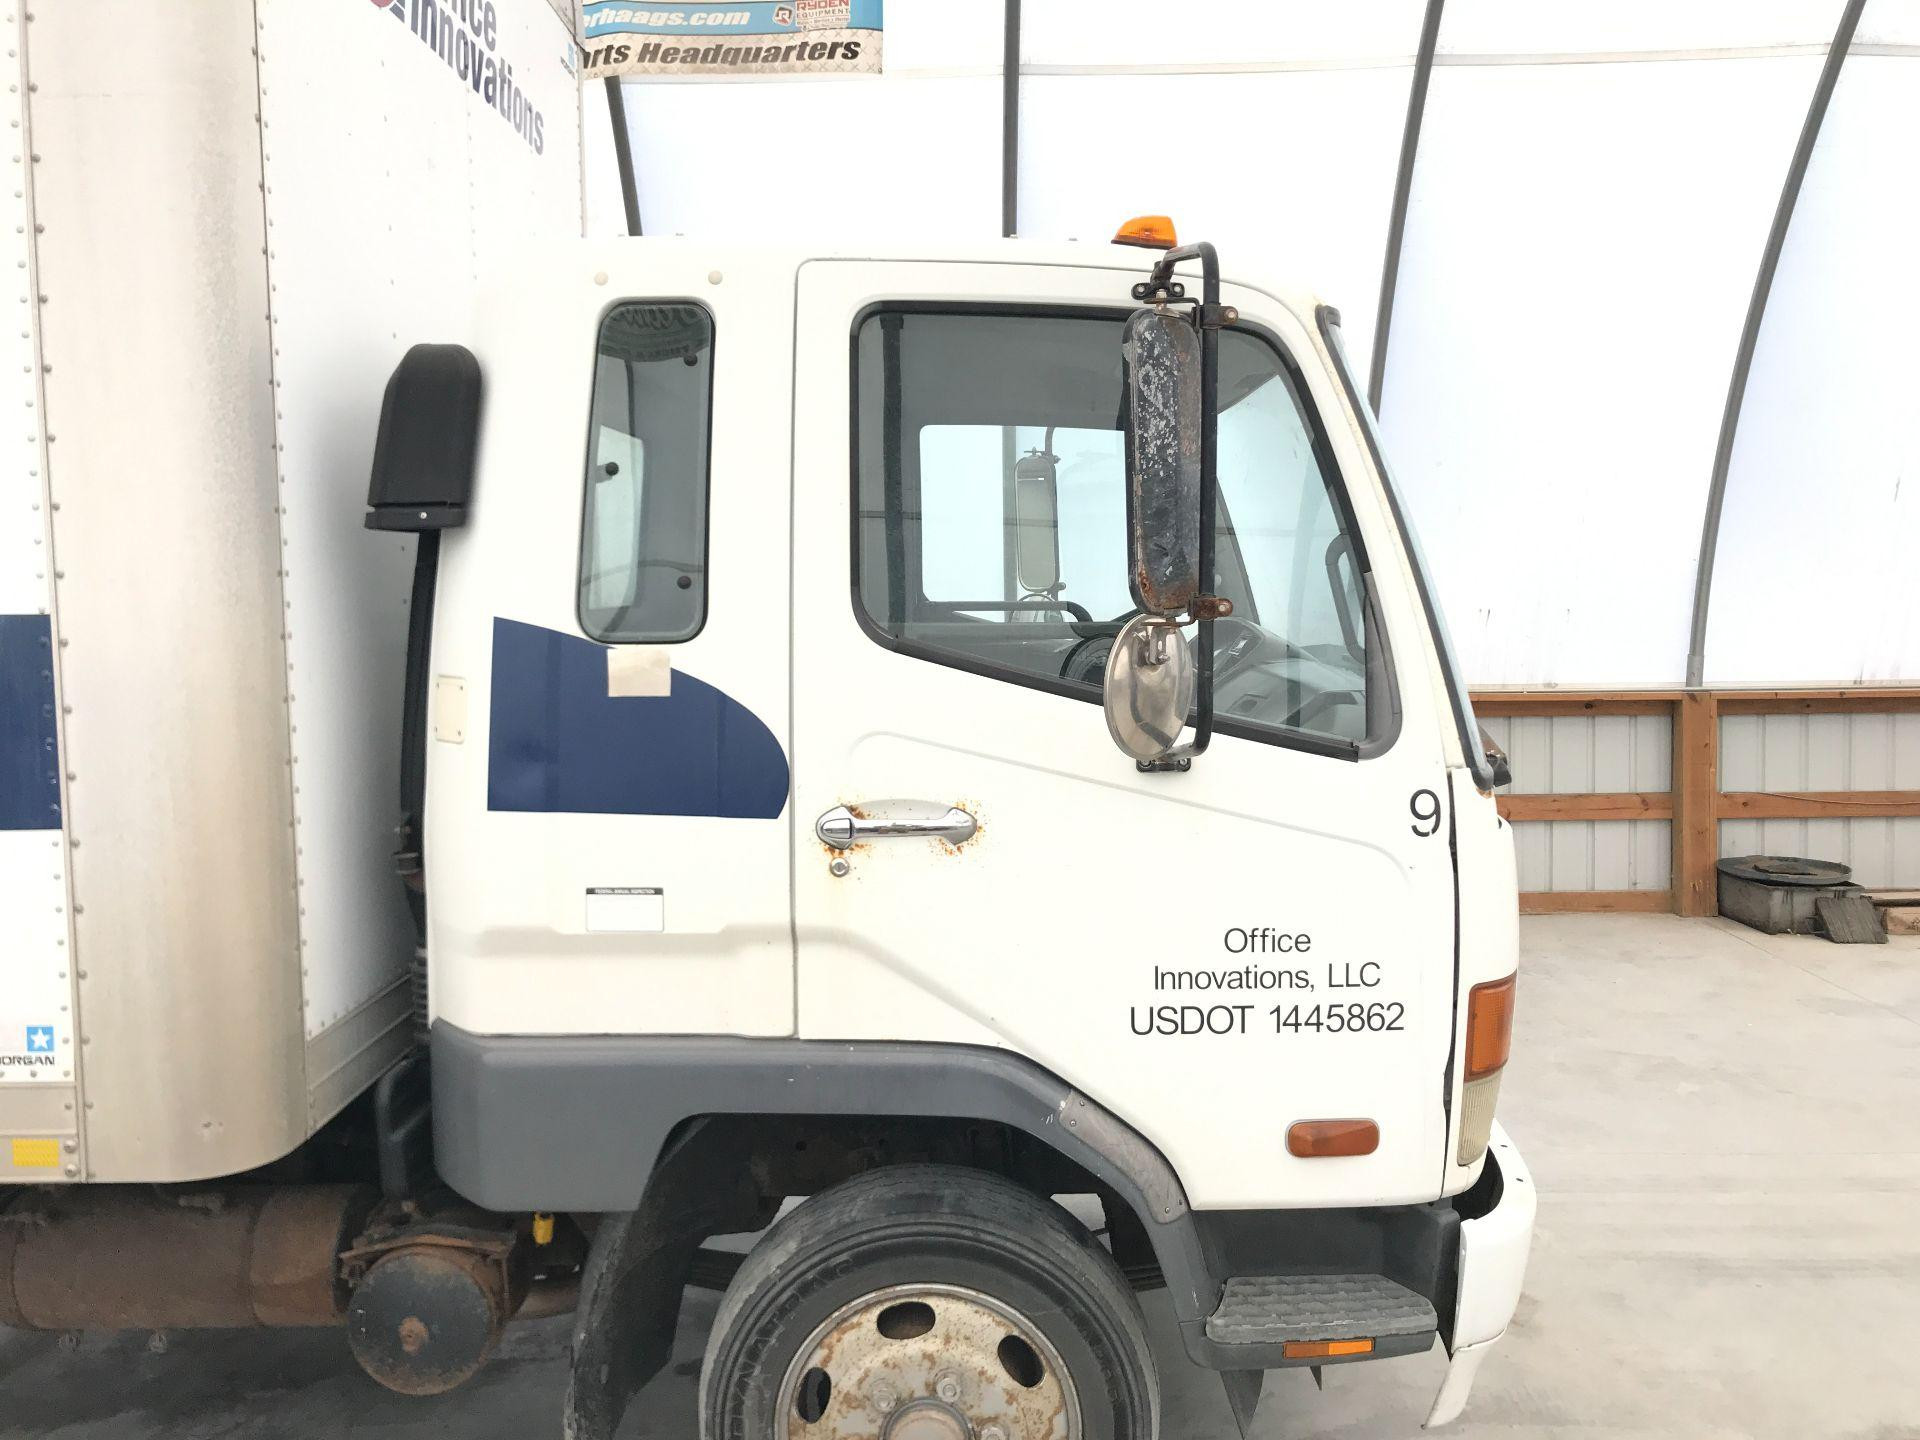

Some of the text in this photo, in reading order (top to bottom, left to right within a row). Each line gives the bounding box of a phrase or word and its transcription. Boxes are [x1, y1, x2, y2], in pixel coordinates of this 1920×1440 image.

[796, 8, 850, 19] EQUIPMENT
[637, 40, 861, 66] Headquarters
[1409, 788, 1441, 837] 9
[1223, 927, 1312, 953] Office
[1153, 961, 1382, 992] Innovations, LLC
[1130, 1002, 1405, 1036] USDOT 1445862
